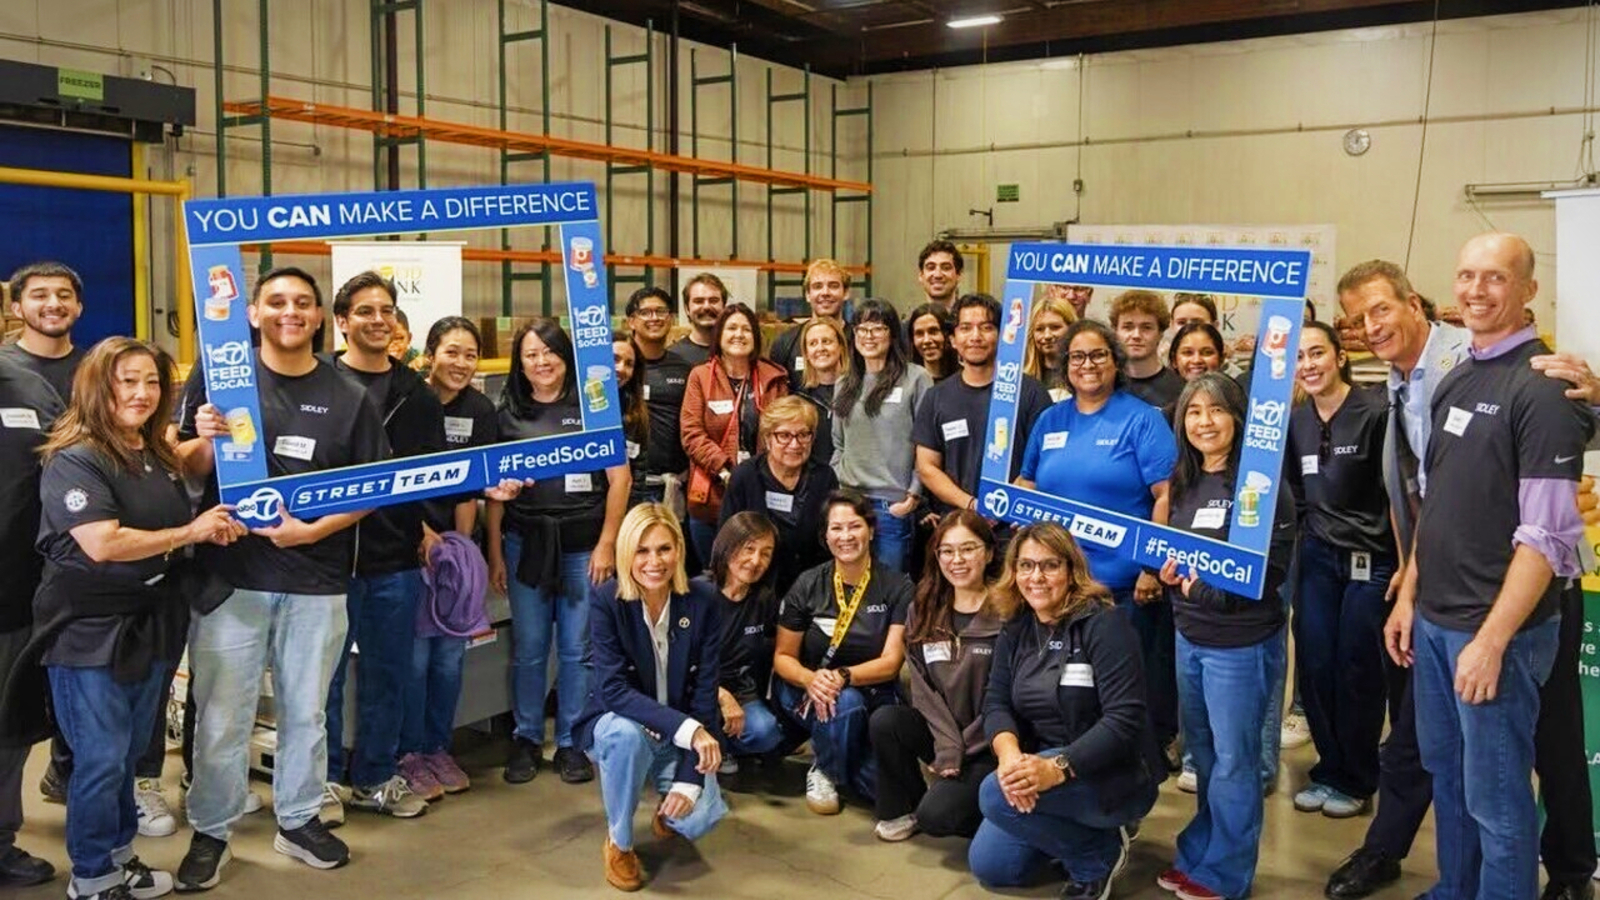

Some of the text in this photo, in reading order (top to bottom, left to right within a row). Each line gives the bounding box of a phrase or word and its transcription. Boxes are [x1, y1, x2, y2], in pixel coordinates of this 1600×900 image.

[193, 191, 590, 233] YOU CAN MAKE A DIFFERENCE
[1014, 251, 1303, 285] YOU CAN MAKE A DIFFERENCE
[576, 327, 608, 340] FEED
[209, 365, 251, 381] FEED
[210, 378, 253, 391] SoCAL
[994, 380, 1016, 393] FEED
[300, 404, 329, 413] SIDLEY
[1247, 423, 1282, 441] FEED
[1245, 437, 1279, 452] SoCAL
[498, 439, 615, 473] #FeedSoCal
[298, 479, 390, 504] STREET
[400, 468, 461, 487] TEAM
[1014, 503, 1071, 527] STREET
[1076, 520, 1118, 542] TEAM
[1145, 537, 1252, 584] #FeedSoCal
